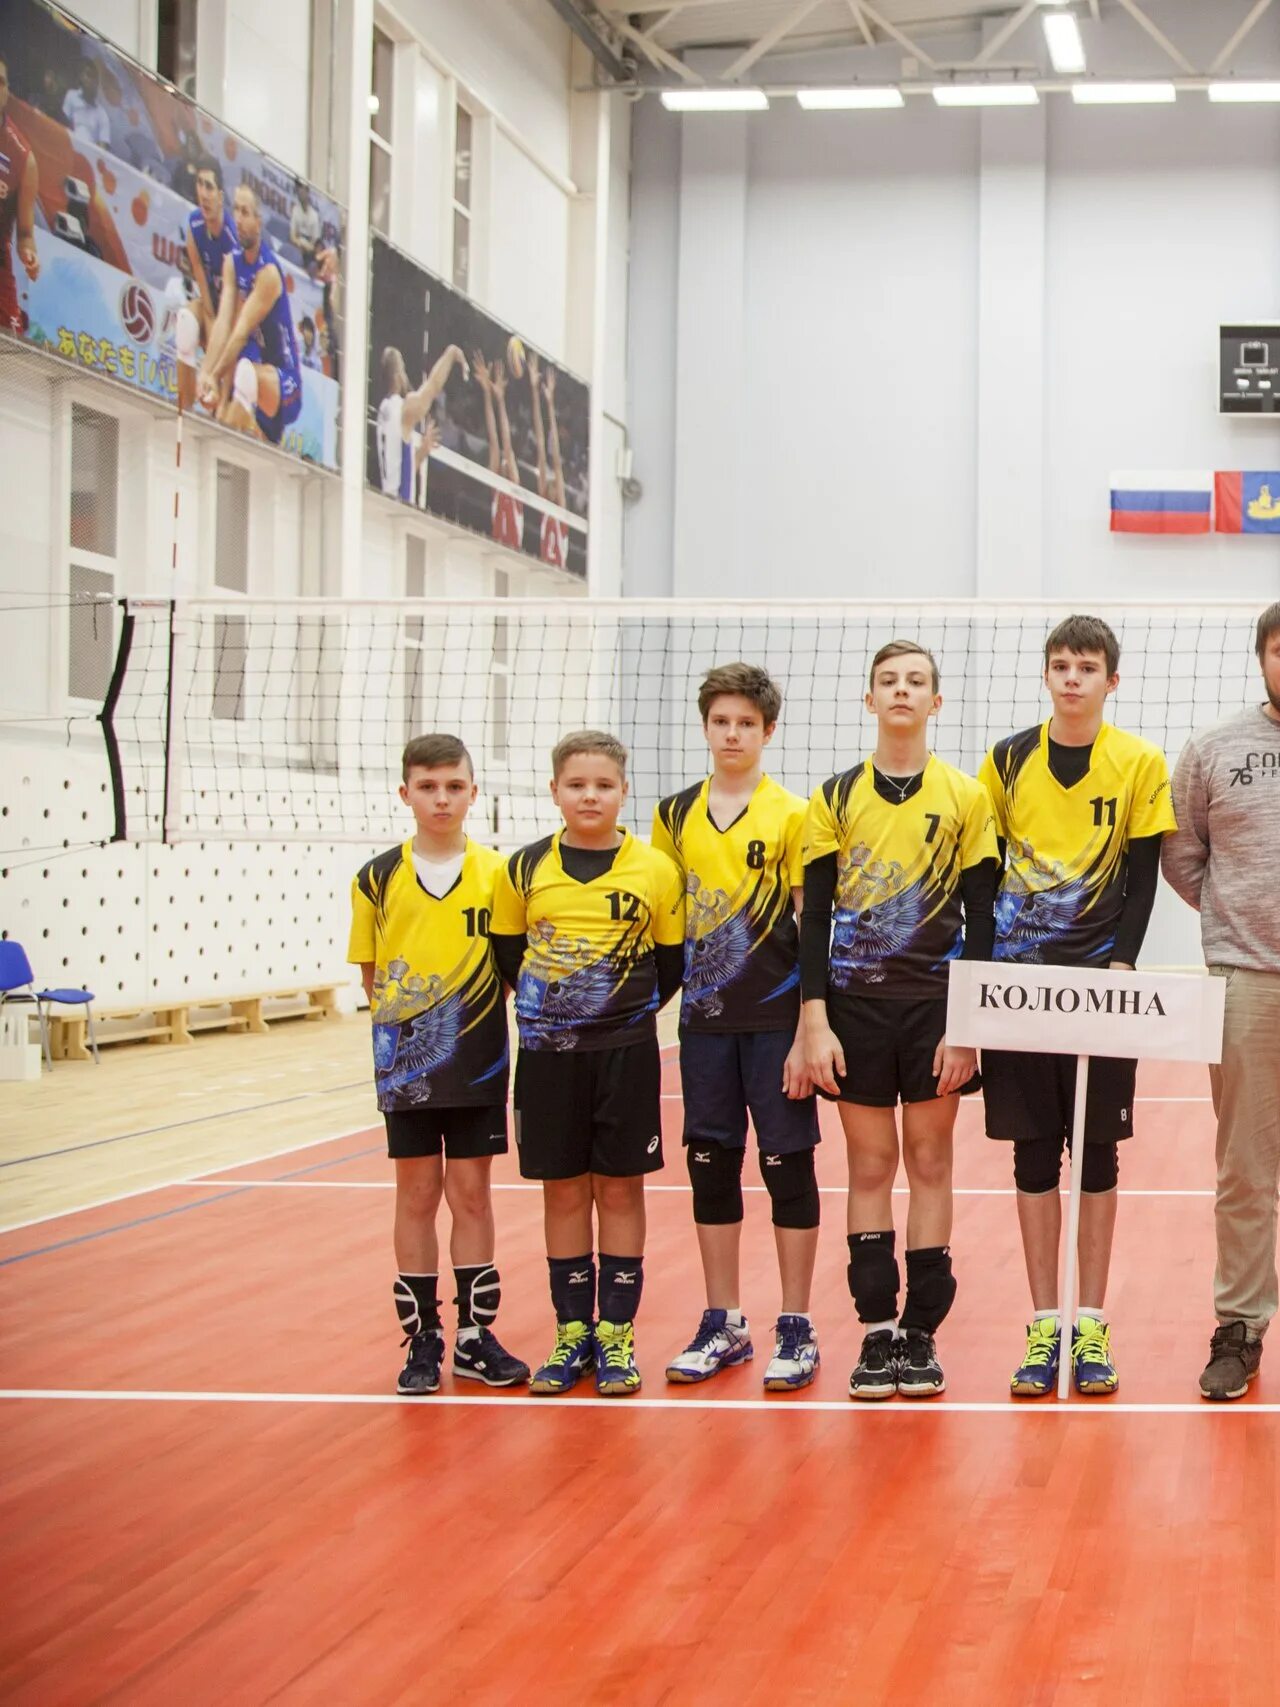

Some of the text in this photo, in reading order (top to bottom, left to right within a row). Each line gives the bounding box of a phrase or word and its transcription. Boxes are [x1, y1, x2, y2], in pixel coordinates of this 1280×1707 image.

[1229, 767, 1253, 787] 76
[1089, 797, 1117, 826] 11
[924, 813, 940, 843] 7
[746, 840, 766, 870] 8
[604, 891, 641, 922] 12
[461, 907, 491, 938] 10
[979, 984, 1167, 1016] КОЛОМНА
